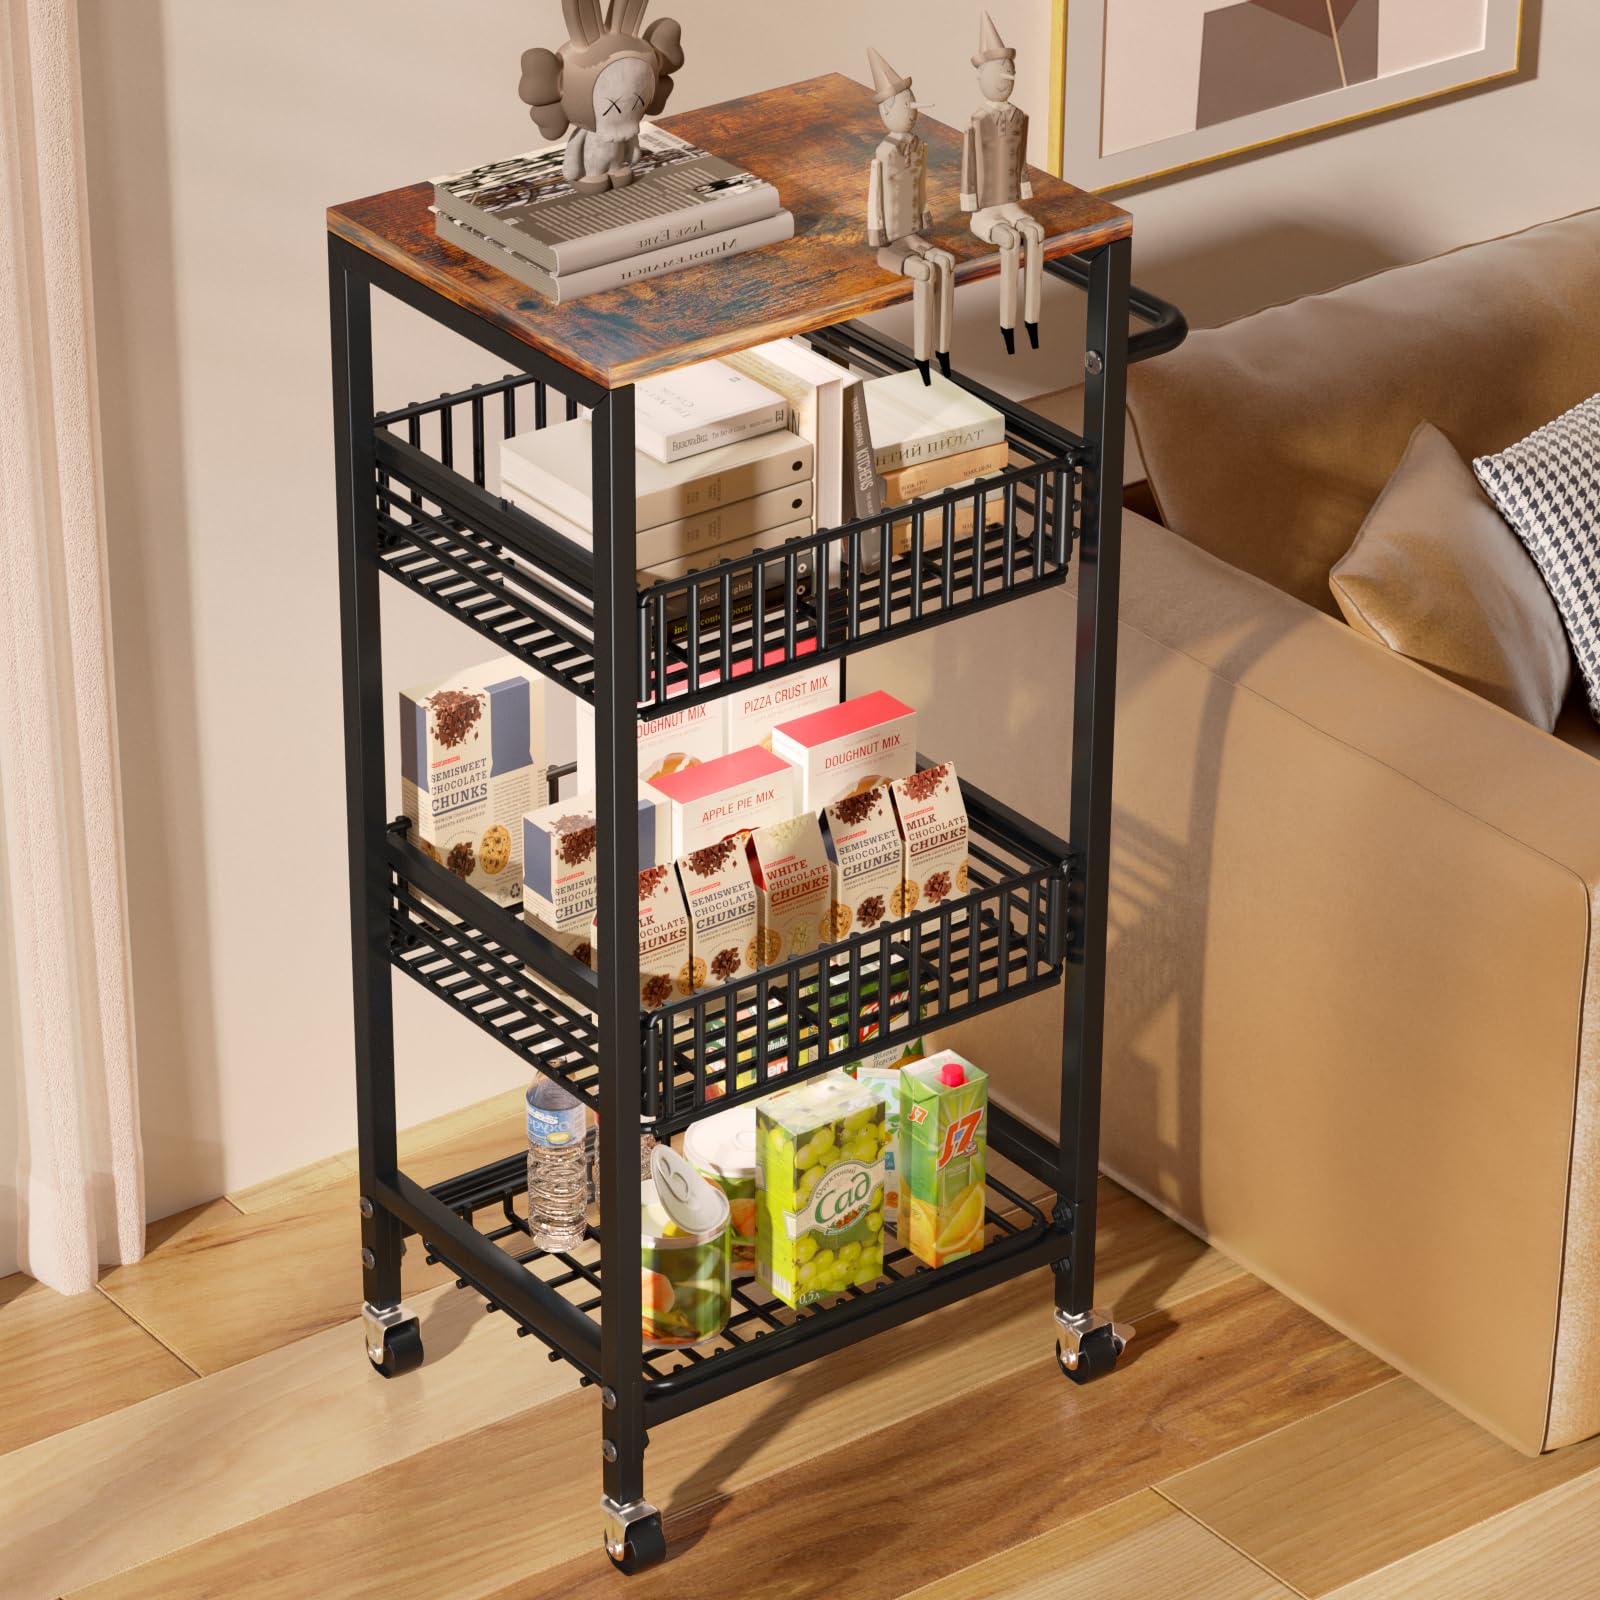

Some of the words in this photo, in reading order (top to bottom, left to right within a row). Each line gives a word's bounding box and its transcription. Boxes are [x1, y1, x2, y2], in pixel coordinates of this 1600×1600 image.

[928, 429, 984, 453] ПИЛАТ
[855, 447, 874, 491] KITCHENS
[744, 694, 772, 714] PIZZA
[774, 682, 807, 704] CRUST
[809, 676, 829, 695] MIX
[637, 711, 684, 738] OUGHNUT
[687, 704, 707, 721] MIX
[825, 742, 879, 769] DOUGHNUT
[882, 734, 901, 751] MIX
[431, 757, 487, 783] SEMISWEET
[431, 770, 487, 796] CHOCOLATE
[431, 783, 488, 812] CHUNKS
[702, 803, 734, 823] APPLE
[736, 797, 753, 814] PIE
[755, 789, 775, 805] MIX
[906, 813, 937, 832] MILK
[908, 815, 966, 841] CHOCOLATE
[839, 829, 897, 855] SEMISWEET
[841, 839, 900, 865] CHOCOLATE
[910, 825, 967, 853] CHUNKS
[766, 859, 808, 880] WHITE
[843, 849, 900, 877] CHUNKS
[555, 875, 597, 897] SEMISW
[769, 864, 828, 891] CHOCOLATE
[771, 875, 829, 903] CHUNKS
[555, 887, 597, 906] CHOCOL
[692, 881, 751, 908] SEMISWEET
[695, 890, 755, 918] CHOCOLATE
[555, 898, 597, 920] CHUN
[639, 915, 655, 928] LK
[696, 901, 756, 930] CHUNKS
[639, 916, 686, 939] OCOLATE
[639, 927, 687, 951] HUNKS
[814, 1171, 871, 1224] Сад
